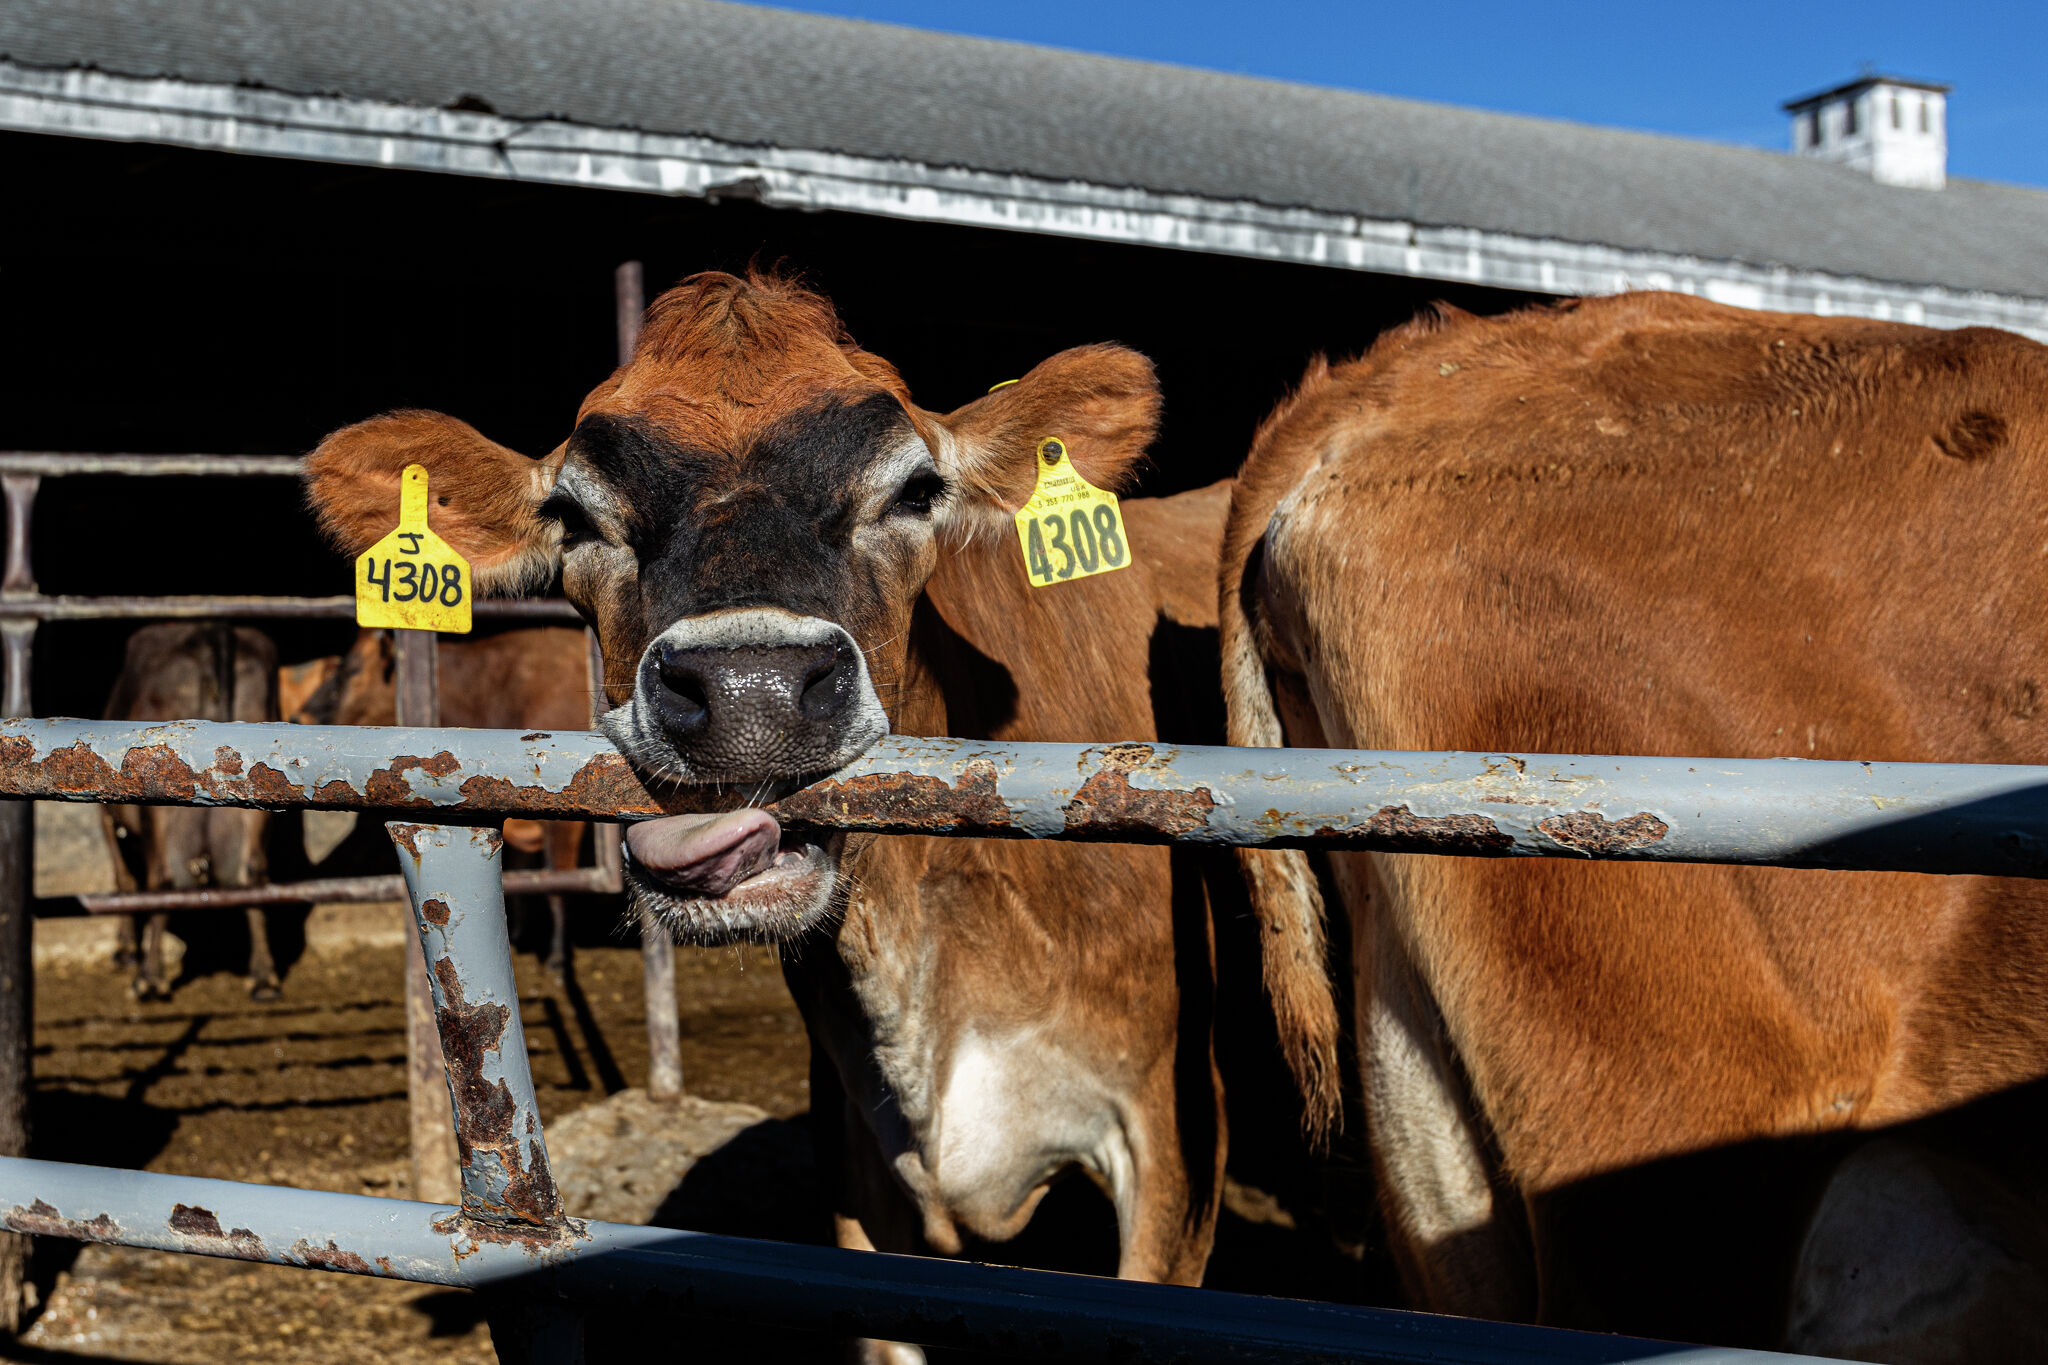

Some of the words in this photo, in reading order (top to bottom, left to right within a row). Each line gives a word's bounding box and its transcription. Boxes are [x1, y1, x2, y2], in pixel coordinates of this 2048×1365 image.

[397, 532, 424, 555] J
[1028, 504, 1124, 582] 4308
[368, 557, 462, 607] 4308
